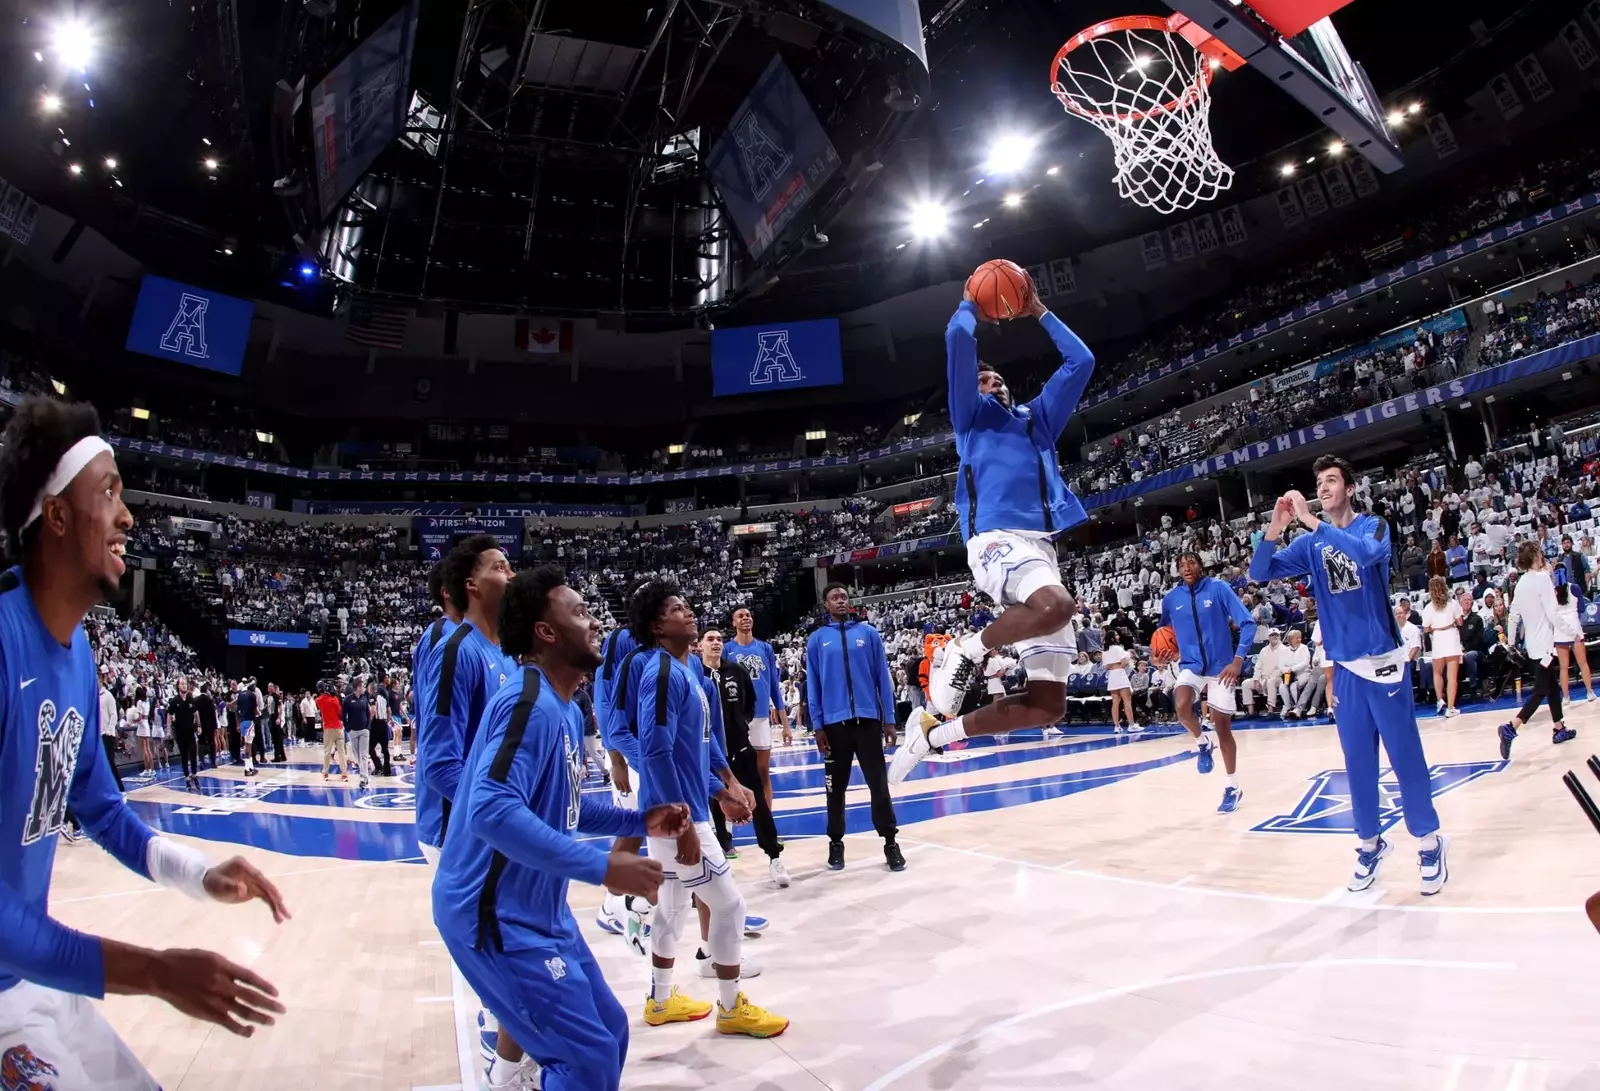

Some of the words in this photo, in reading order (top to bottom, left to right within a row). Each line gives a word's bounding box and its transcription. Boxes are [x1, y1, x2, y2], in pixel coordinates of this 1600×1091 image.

[159, 293, 210, 359] A
[749, 330, 802, 385] A
[1276, 370, 1310, 387] Pinnacle
[1193, 423, 1327, 478] MEMPHIS
[1343, 380, 1467, 431] TIGERS
[247, 495, 260, 507] 95
[678, 501, 694, 512] 2.6
